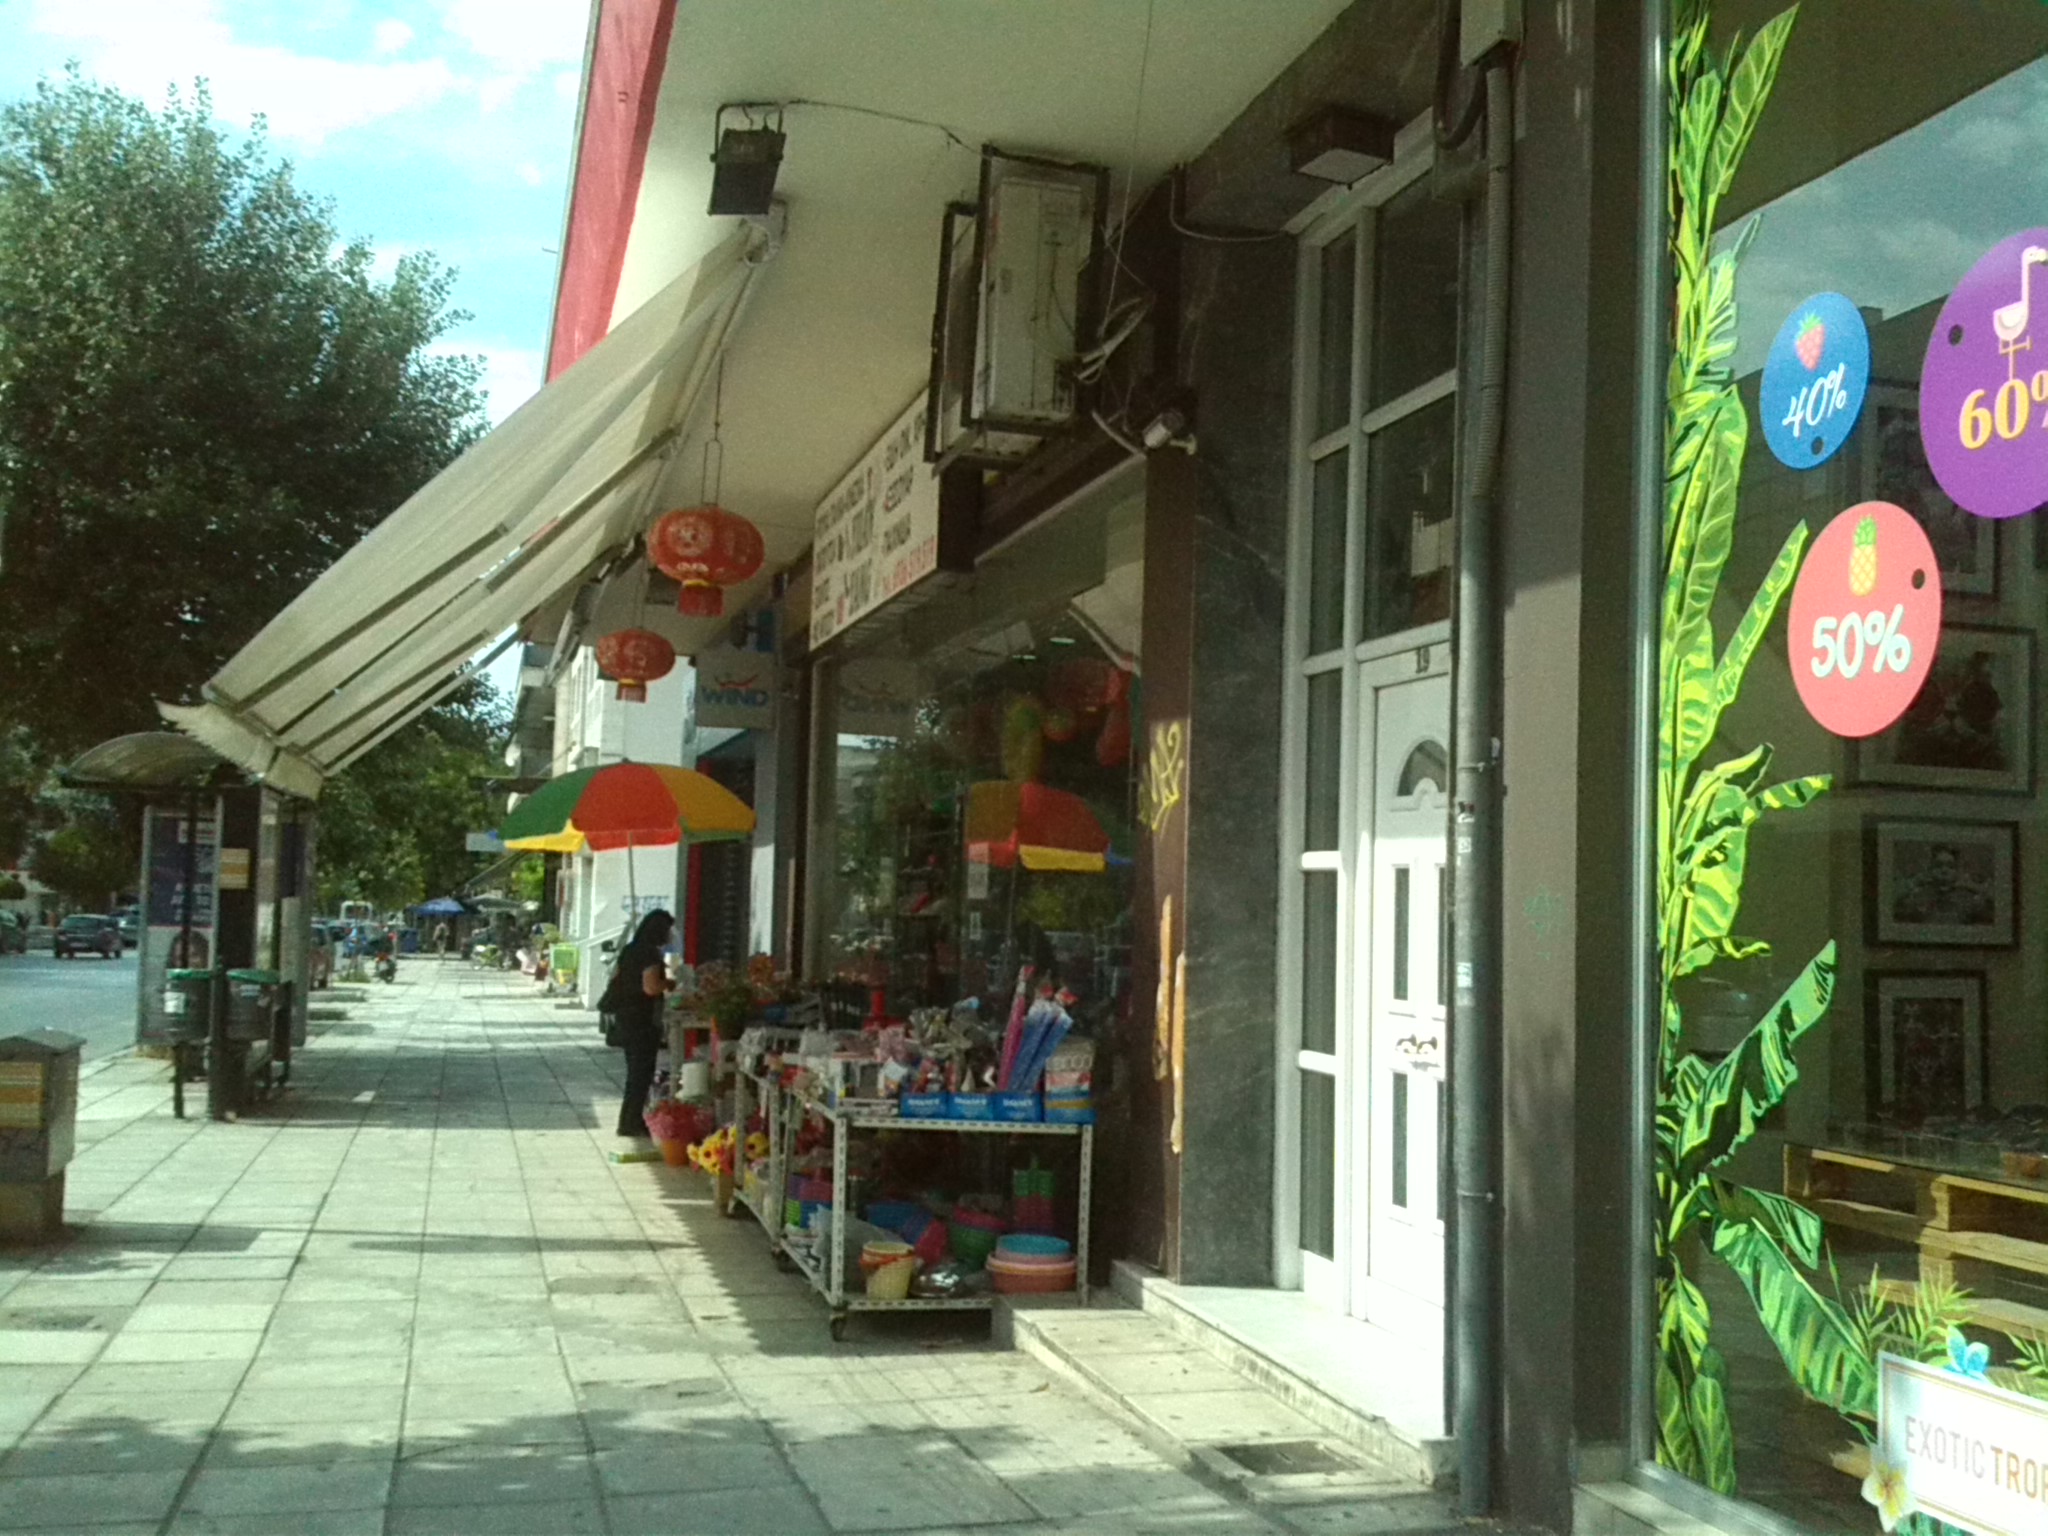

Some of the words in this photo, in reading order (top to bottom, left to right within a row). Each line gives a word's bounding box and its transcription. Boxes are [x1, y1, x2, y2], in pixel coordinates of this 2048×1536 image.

[1782, 362, 1847, 437] 40%
[1811, 603, 1911, 680] 50%
[1905, 1414, 1986, 1479] EXOTIC
